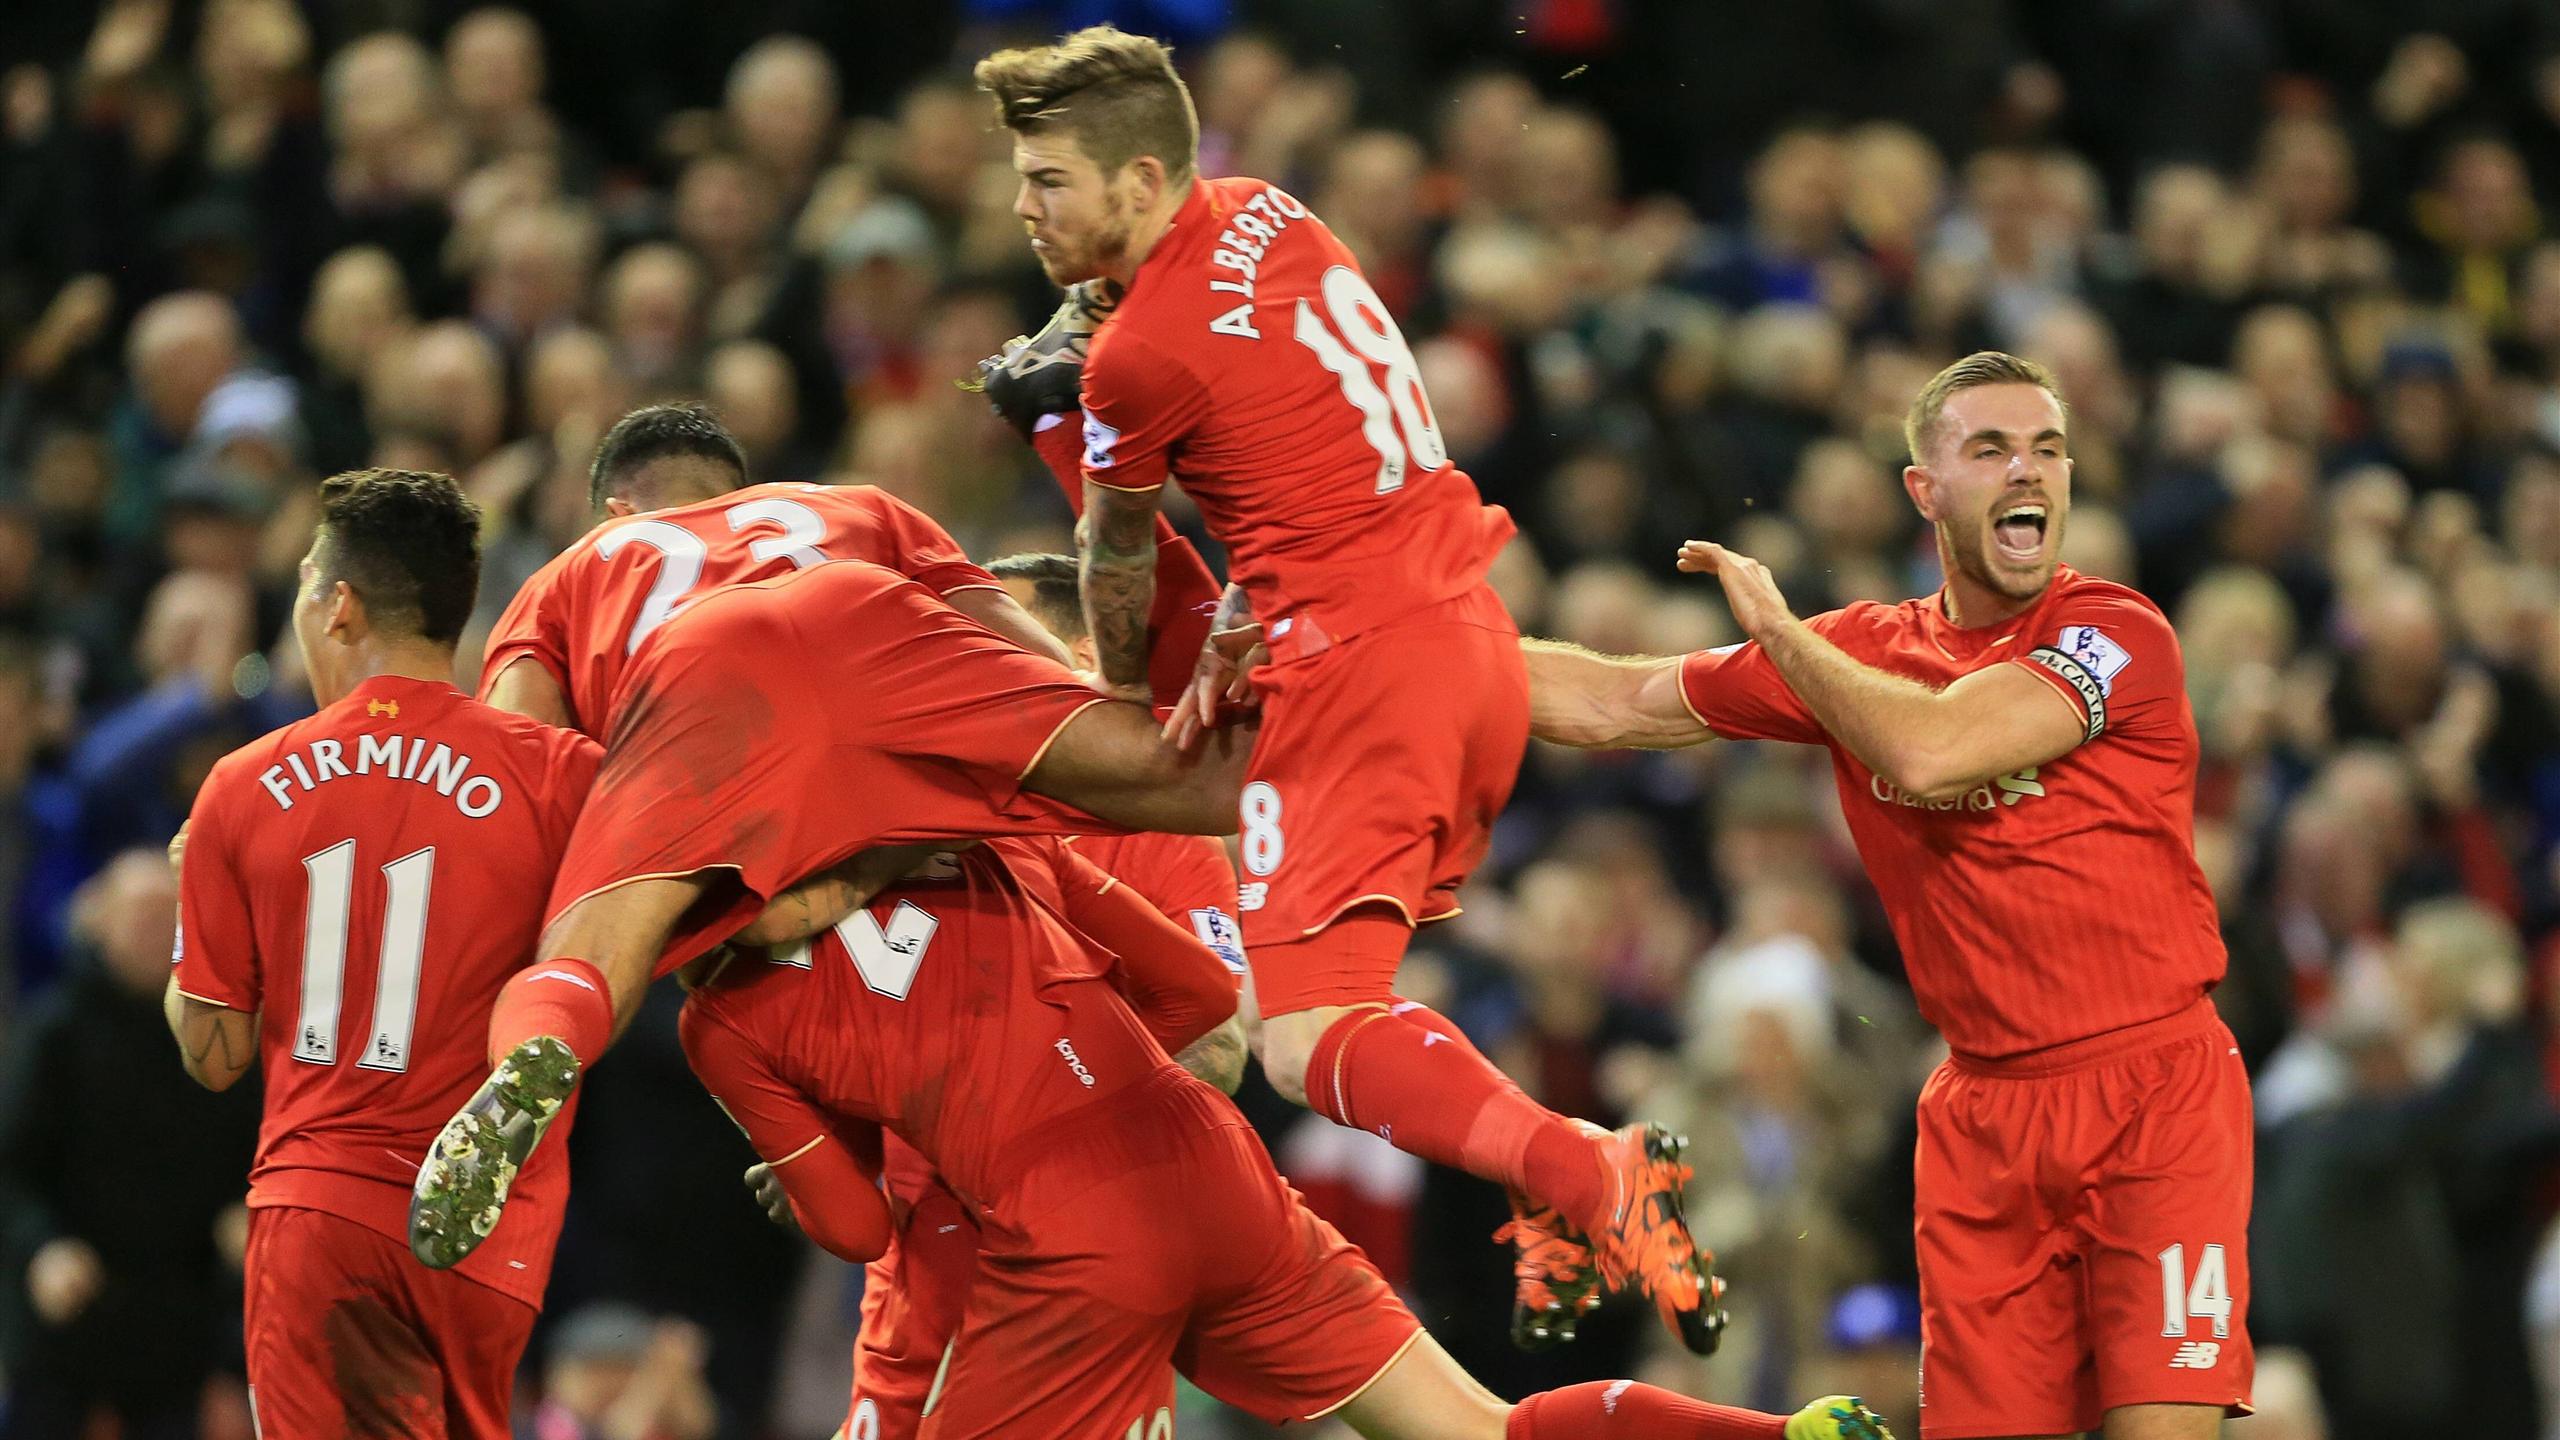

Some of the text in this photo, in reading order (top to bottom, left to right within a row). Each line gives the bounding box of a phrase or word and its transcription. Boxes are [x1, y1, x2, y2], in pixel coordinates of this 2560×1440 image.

[1209, 187, 1305, 340] ALBERTO
[1294, 264, 1447, 495] 18
[594, 497, 828, 658] 23
[258, 734, 503, 818] FIRMINO
[1239, 781, 1285, 876] 8
[290, 838, 436, 1073] 11
[2157, 1243, 2234, 1339] 14
